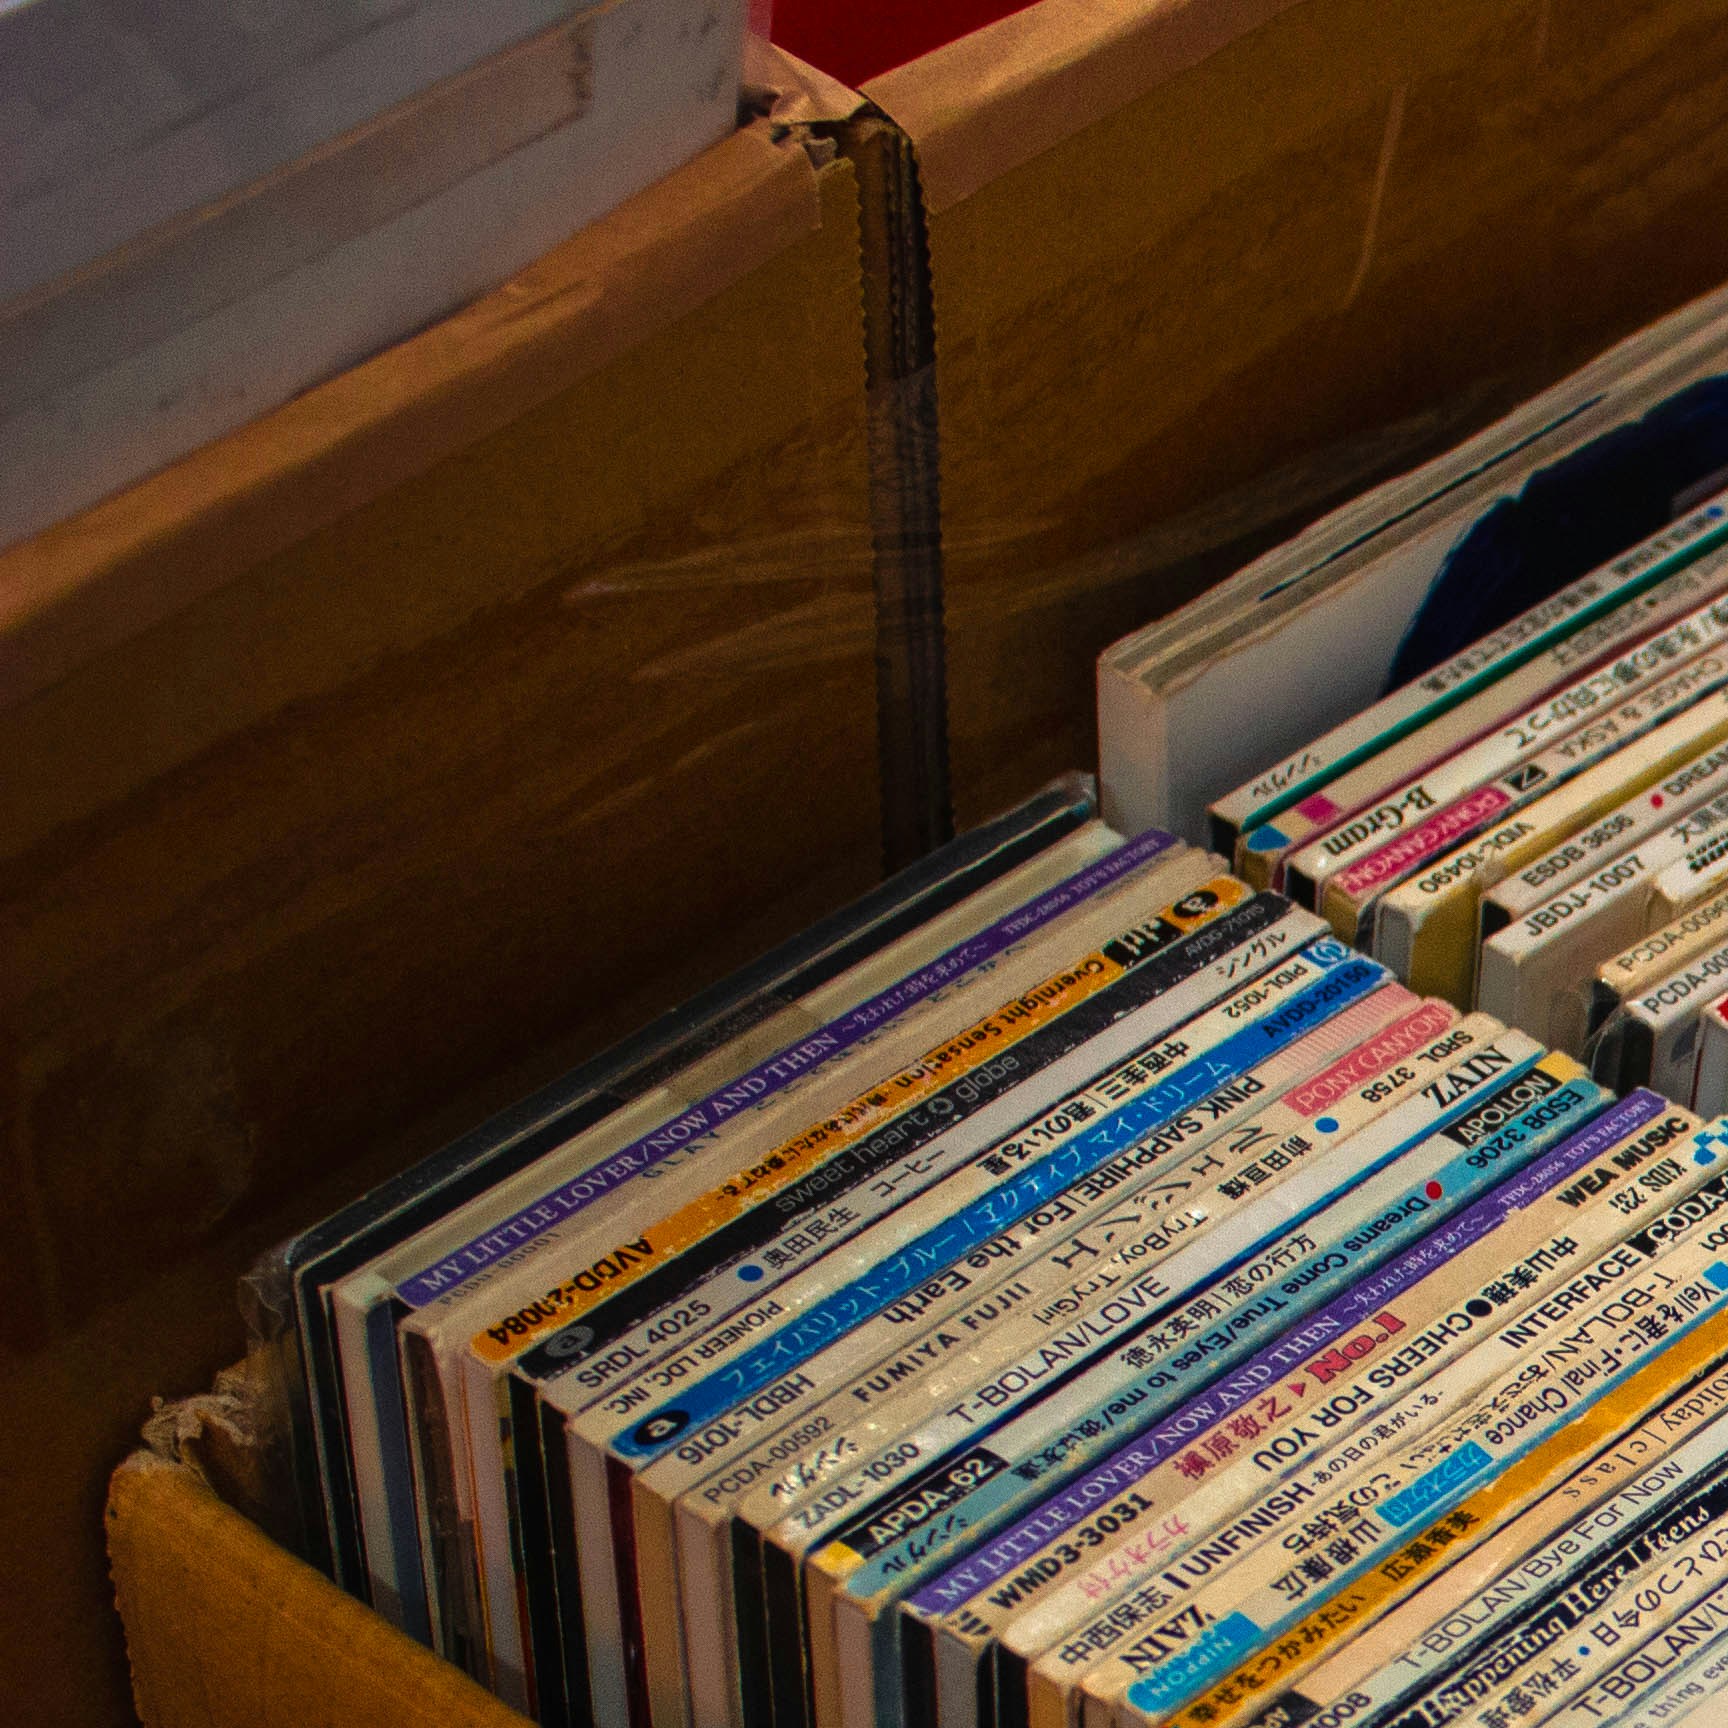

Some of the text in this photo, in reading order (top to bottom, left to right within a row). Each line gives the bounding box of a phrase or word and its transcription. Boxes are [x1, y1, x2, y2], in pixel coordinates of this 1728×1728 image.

[1518, 854, 1652, 938] JBDJ-1007
[418, 1031, 842, 1291] MY LITTLE LOVER/NOW AND THEN
[575, 928, 1293, 1389] SRDL 4025 奥田民生 コーヒー シングル
[673, 1074, 1268, 1466] PINK For the Earth HBDL-1016
[769, 1053, 1026, 1213] sweet heart globe
[1163, 1087, 1587, 1375] ESDB 3206 Dreams Come True/Eyes
[789, 1273, 1173, 1531] ZADL-1030 T-BOLAN/LOVE
[847, 1280, 1035, 1403] FUMIYA FUJII
[862, 1072, 1556, 1544] APDA-62 徳永英明 恋の行方 APOLLON
[985, 1115, 1693, 1610] WMD3-3031 No.1 WEA MUSIC
[1054, 1584, 1175, 1668] 中西保志
[1495, 1247, 1644, 1350] INTERFACE
[1558, 1561, 1641, 1620] Here
